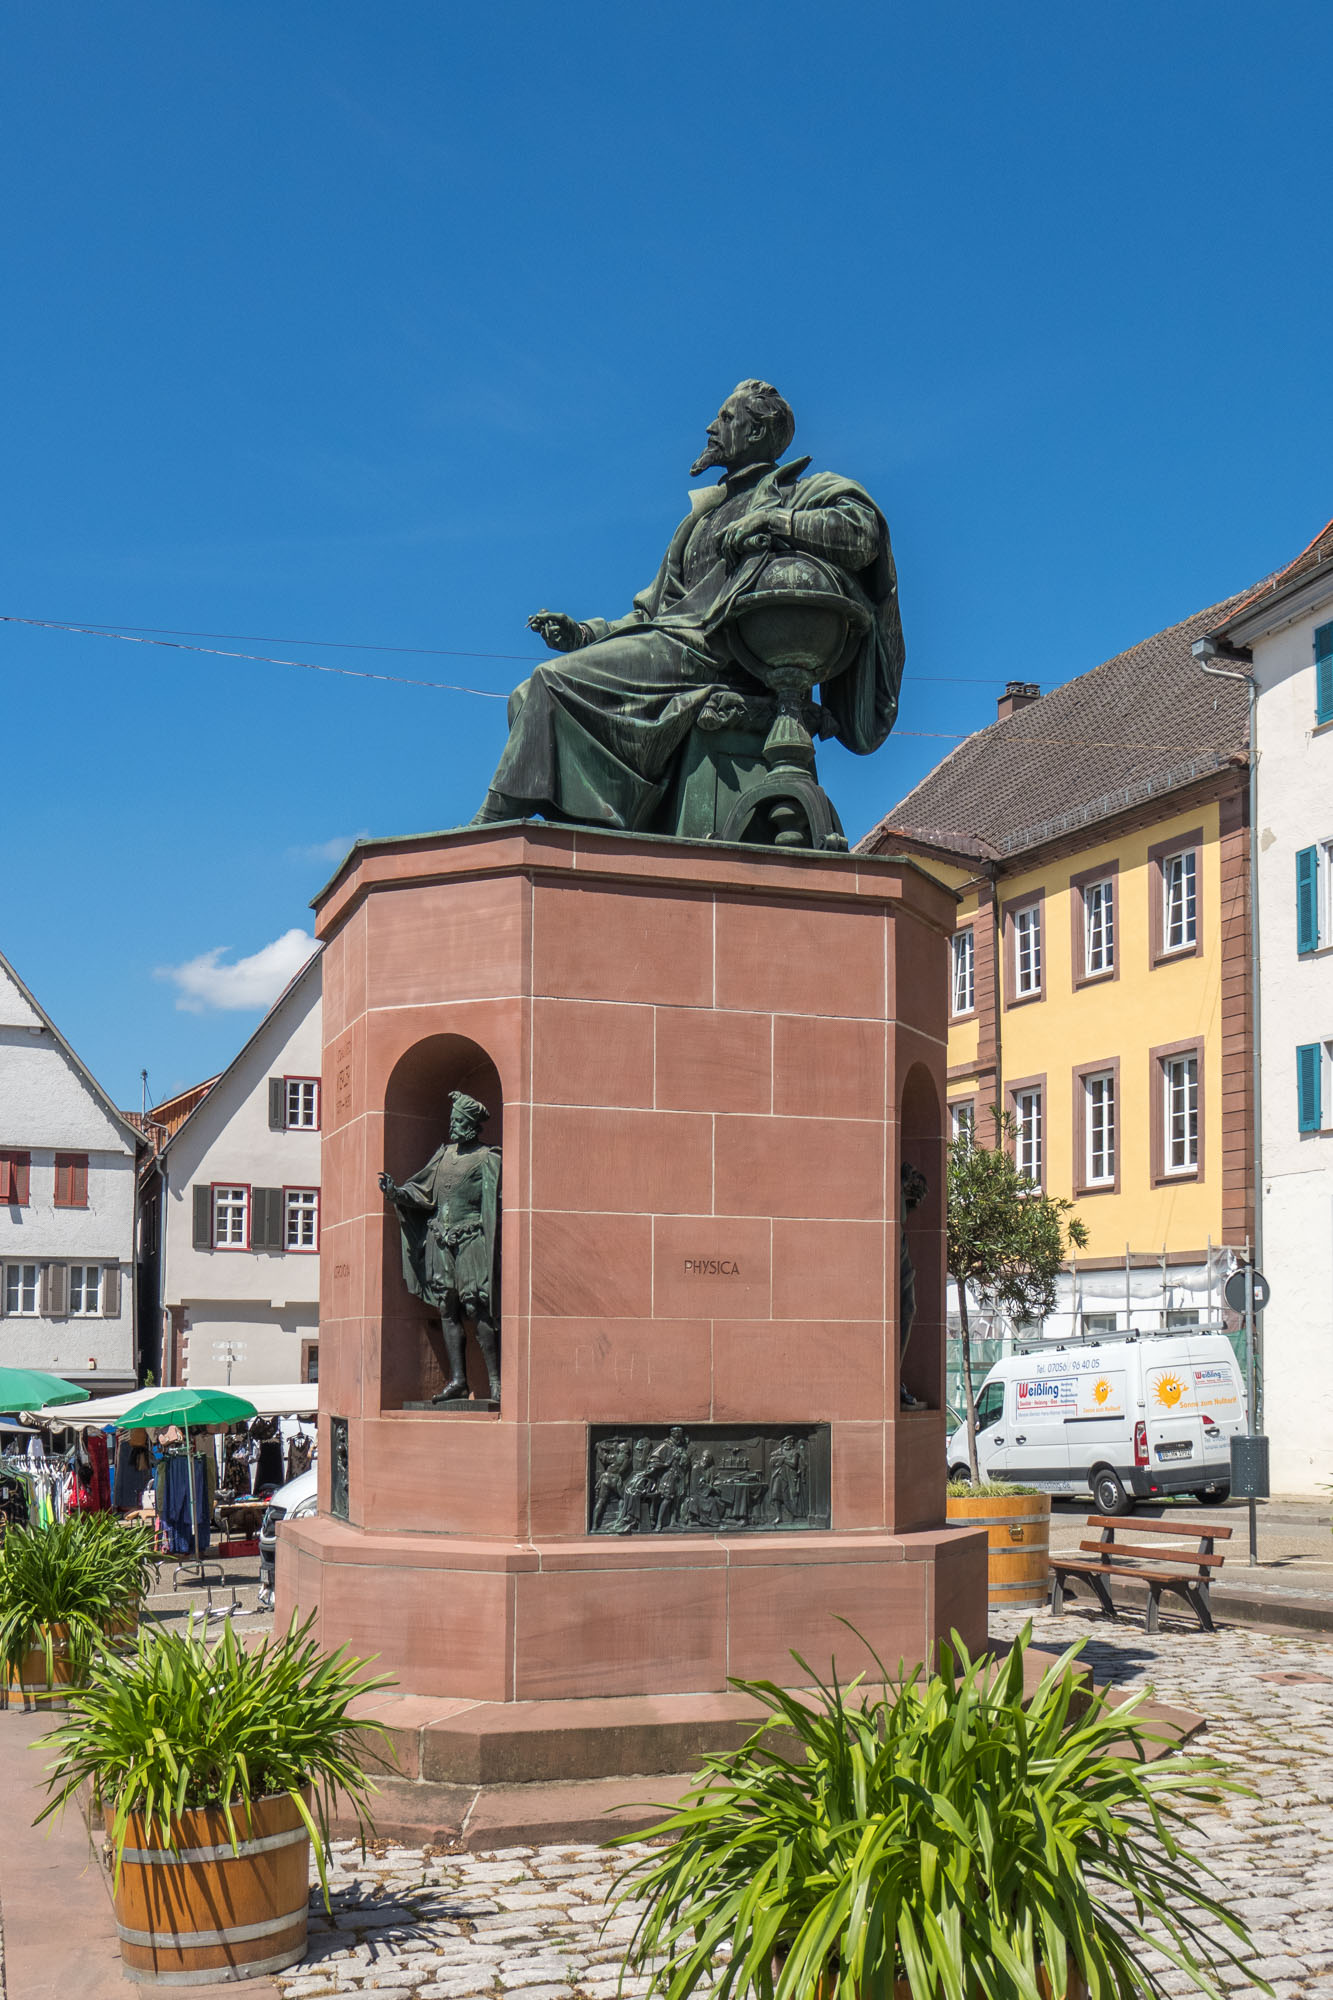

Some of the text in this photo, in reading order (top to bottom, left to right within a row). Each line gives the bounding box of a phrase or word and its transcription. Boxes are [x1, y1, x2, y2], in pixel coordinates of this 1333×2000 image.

[684, 1259, 740, 1275] PHYSICA
[1048, 1363, 1067, 1373] 07056
[1071, 1360, 1081, 1370] 96
[1082, 1359, 1091, 1369] 40
[1091, 1358, 1100, 1368] 05
[1195, 1370, 1221, 1379] Weißling
[1019, 1383, 1059, 1399] Weißling
